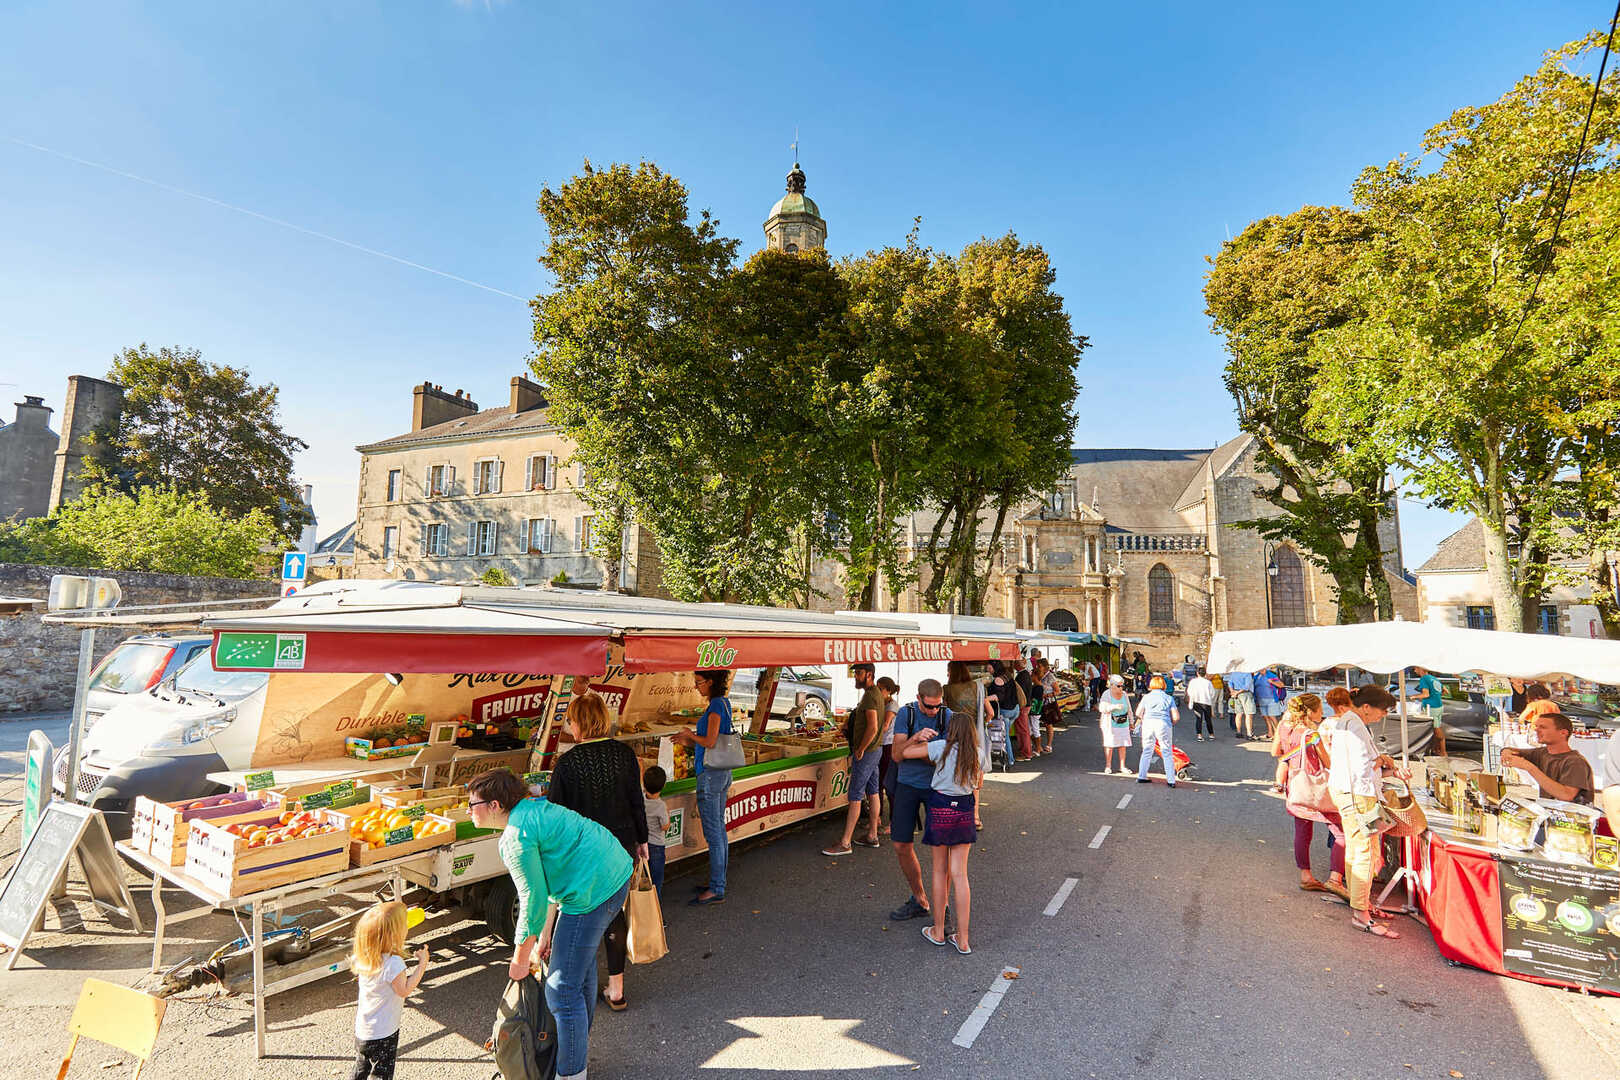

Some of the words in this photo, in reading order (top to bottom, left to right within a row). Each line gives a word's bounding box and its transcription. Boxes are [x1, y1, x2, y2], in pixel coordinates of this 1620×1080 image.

[279, 641, 300, 659] AB
[697, 637, 737, 668] Bio
[824, 639, 882, 662] FRUITS
[887, 643, 898, 662] &
[483, 692, 542, 723] FRUITS
[830, 768, 851, 798] Bi
[724, 795, 757, 825] RUITS
[760, 794, 769, 809] &
[770, 786, 813, 807] LEGUMES
